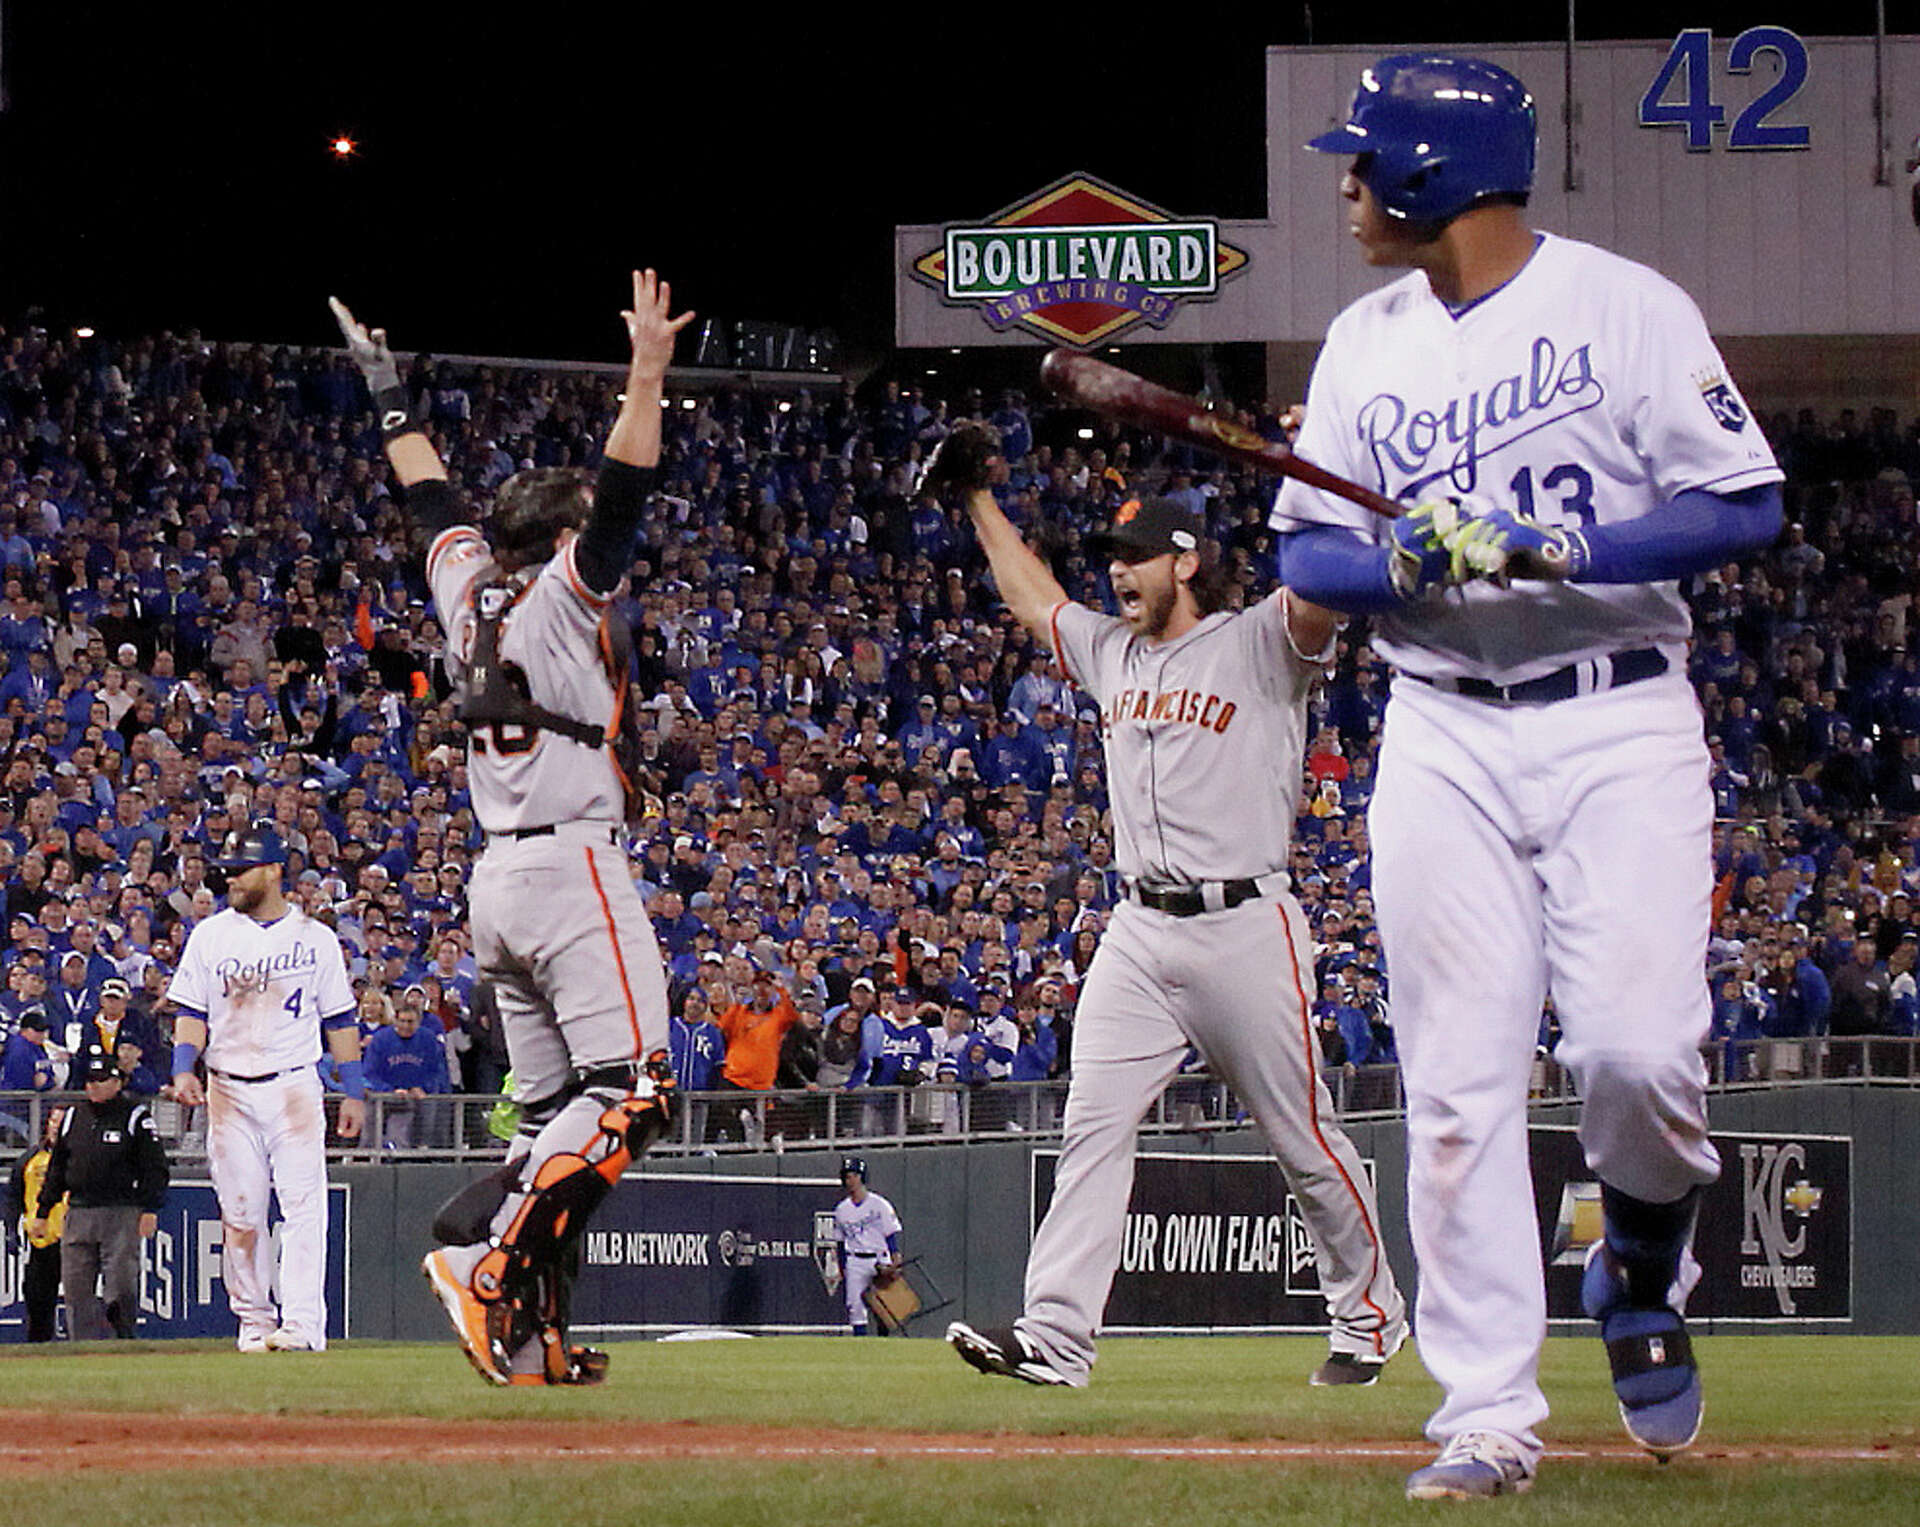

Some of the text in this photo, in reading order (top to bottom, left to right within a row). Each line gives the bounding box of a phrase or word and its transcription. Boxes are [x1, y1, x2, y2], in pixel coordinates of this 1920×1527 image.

[1638, 25, 1811, 151] 42
[956, 235, 1204, 286] BOULEVARD
[995, 282, 1129, 320] BREWING
[1357, 336, 1604, 498] Royals
[1509, 464, 1597, 528] 13
[216, 940, 317, 998] Royals
[284, 987, 303, 1019] 4
[587, 1232, 623, 1265] MLB
[626, 1232, 709, 1266] NETWORK
[1122, 1213, 1282, 1273] UR OWN FLAG
[1740, 1142, 1806, 1314] KC
